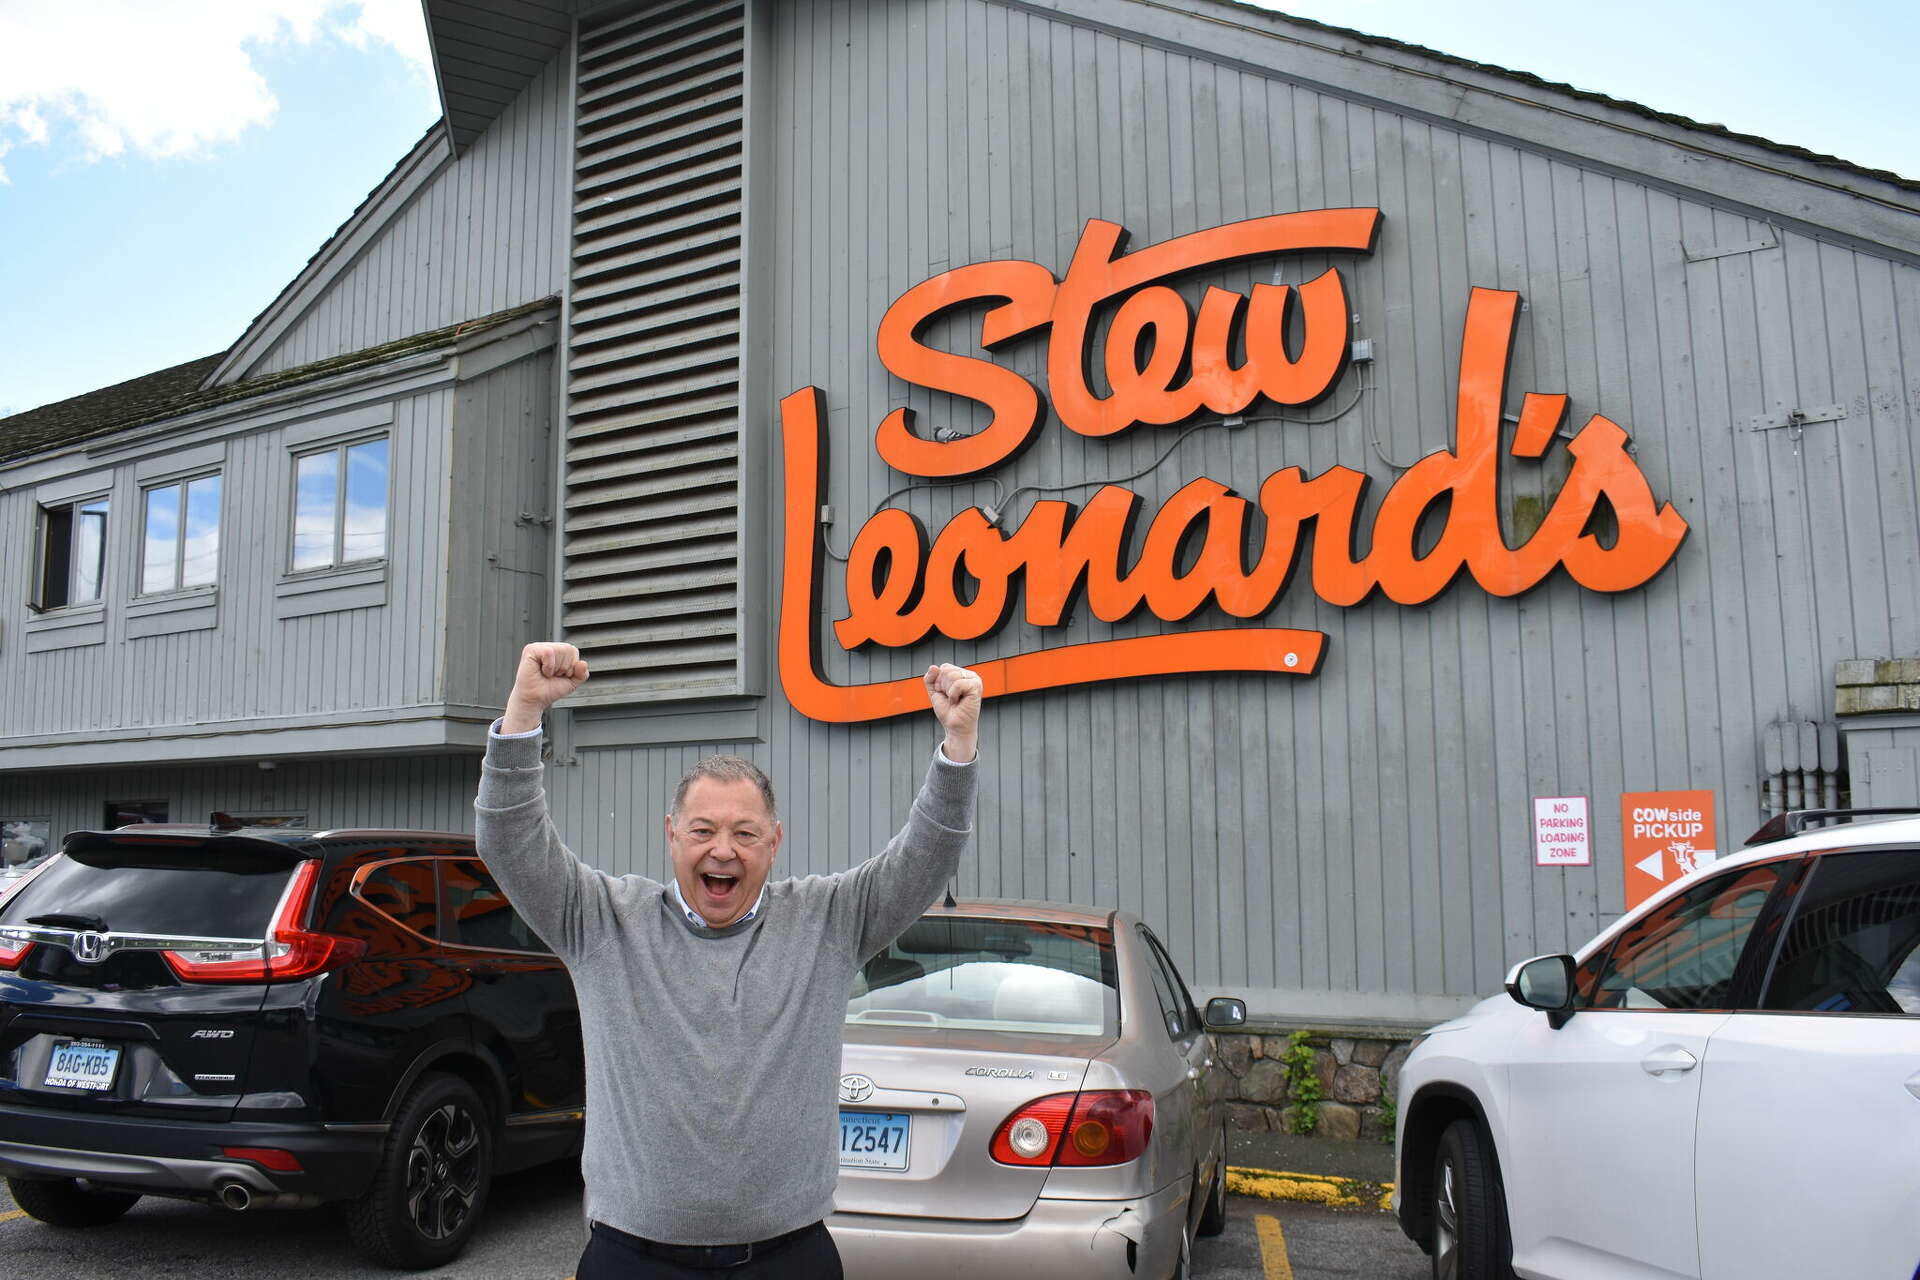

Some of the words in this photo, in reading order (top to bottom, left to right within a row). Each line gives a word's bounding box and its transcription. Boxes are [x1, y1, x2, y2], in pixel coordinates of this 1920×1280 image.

[875, 207, 1384, 479] Stew
[778, 286, 1690, 725] Leonard's
[1553, 804, 1568, 813] NO
[1632, 808, 1702, 822] COWside
[1540, 818, 1584, 828] PARKING
[1633, 823, 1704, 838] PICKUP
[1540, 832, 1585, 843] LOADING
[1549, 848, 1577, 857] ZONE
[190, 1029, 235, 1039] AWD
[965, 1066, 1034, 1079] COROLLA
[45, 1077, 68, 1086] HONDA
[67, 1080, 77, 1088] OF
[841, 1116, 880, 1124] onnecticut
[841, 1125, 904, 1154] 12547
